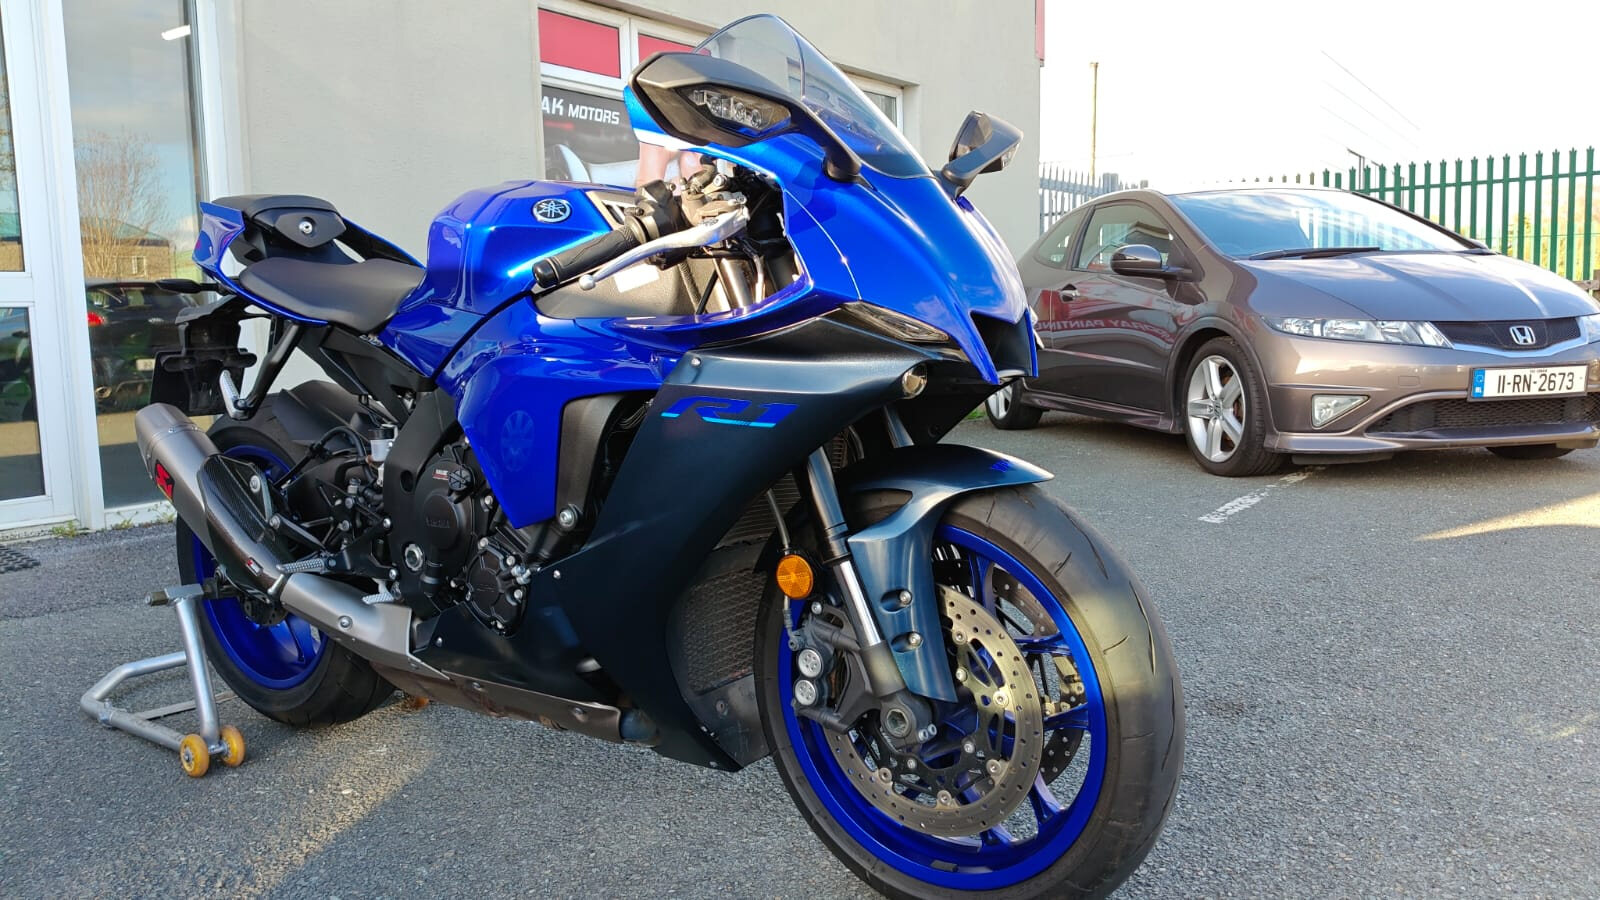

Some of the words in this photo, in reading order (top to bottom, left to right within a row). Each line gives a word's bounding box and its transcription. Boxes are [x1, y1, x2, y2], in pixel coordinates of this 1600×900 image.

[568, 103, 620, 125] MOTORS
[1497, 372, 1575, 393] 11-RN-2673
[660, 396, 800, 429] R1
